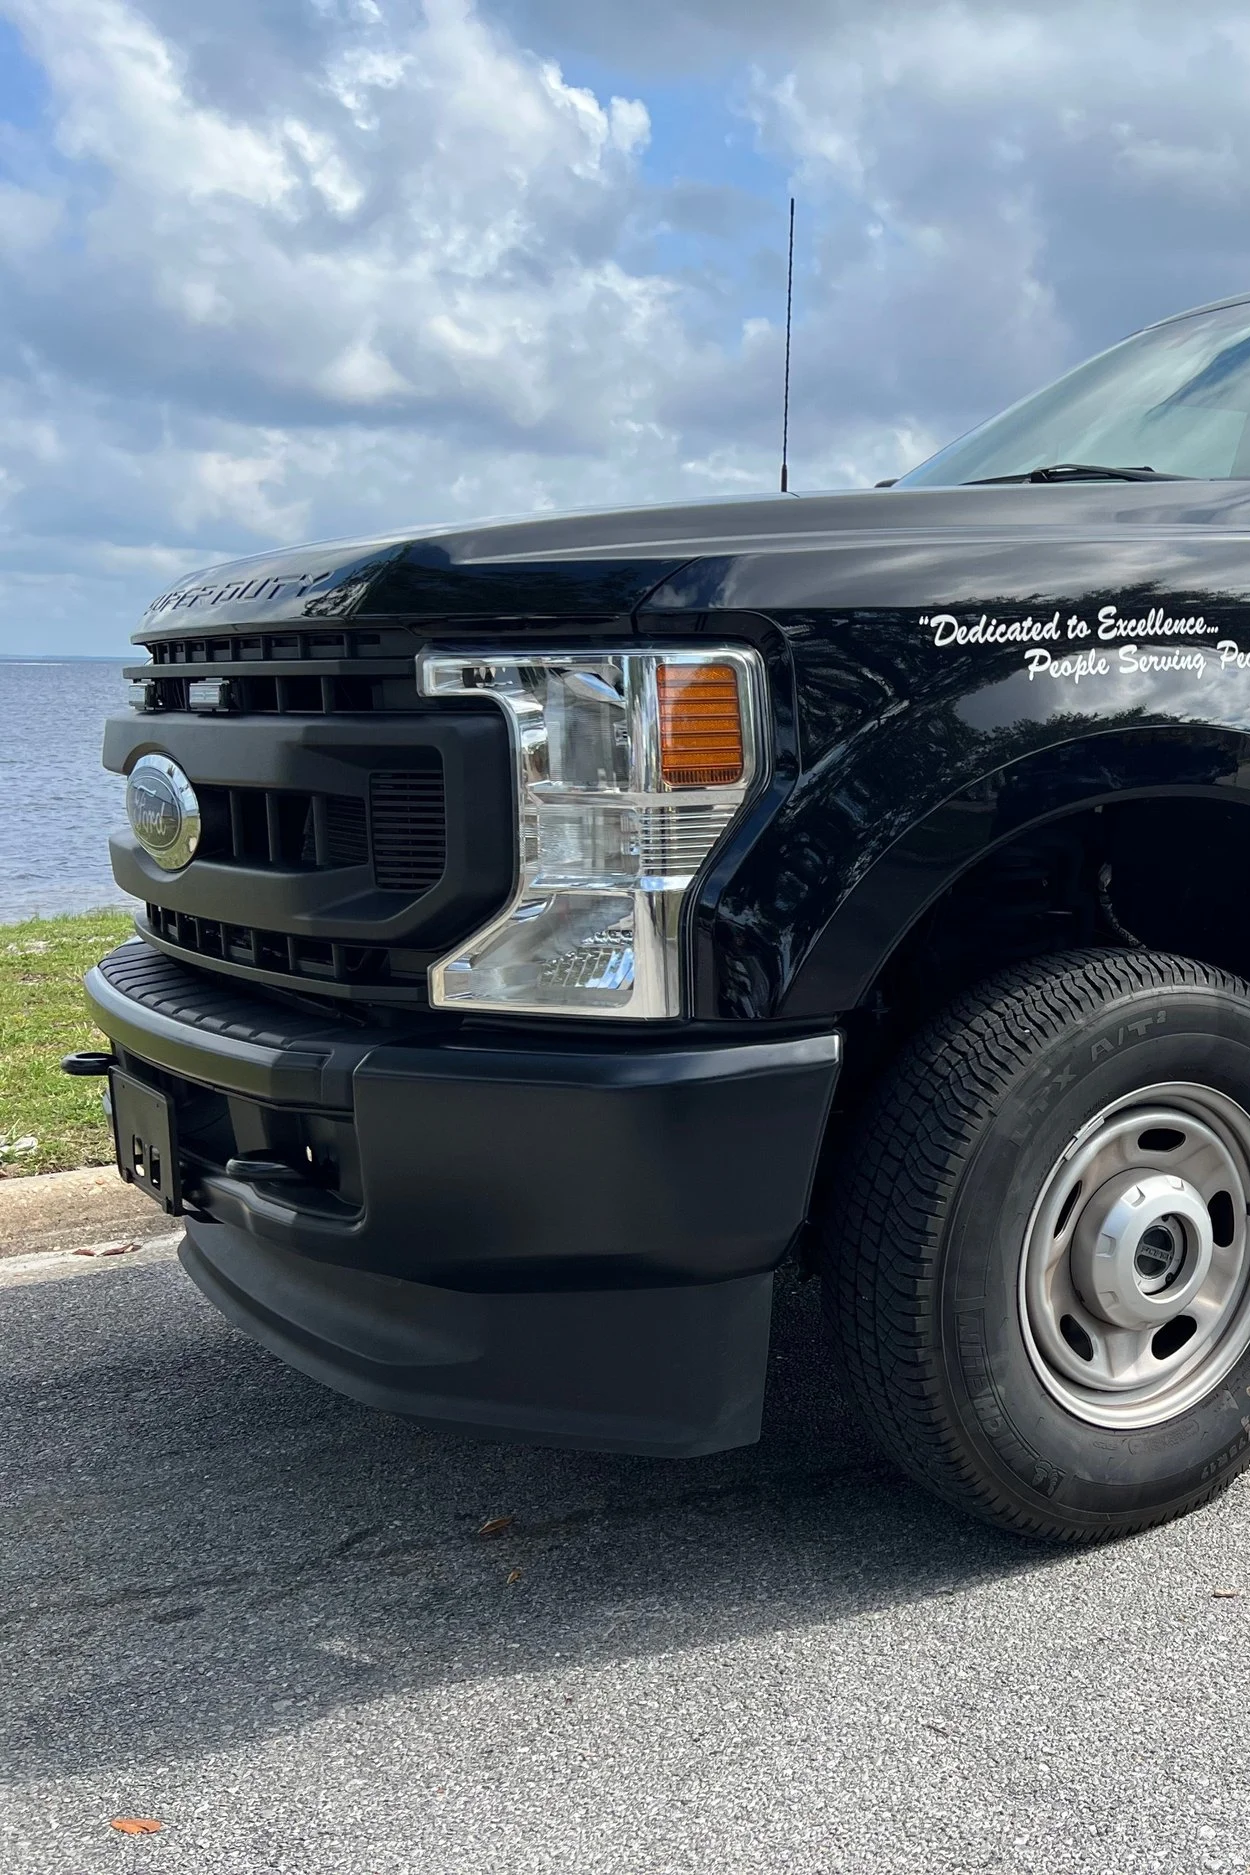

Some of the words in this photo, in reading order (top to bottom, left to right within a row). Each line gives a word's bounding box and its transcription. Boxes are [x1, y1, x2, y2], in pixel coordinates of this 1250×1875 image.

[211, 571, 336, 605] DUTY
[1067, 614, 1091, 640] to
[1023, 648, 1109, 684] People
[1119, 644, 1207, 679] Serving
[133, 784, 168, 836] Ford
[959, 1314, 1037, 1475] MICHELIN
